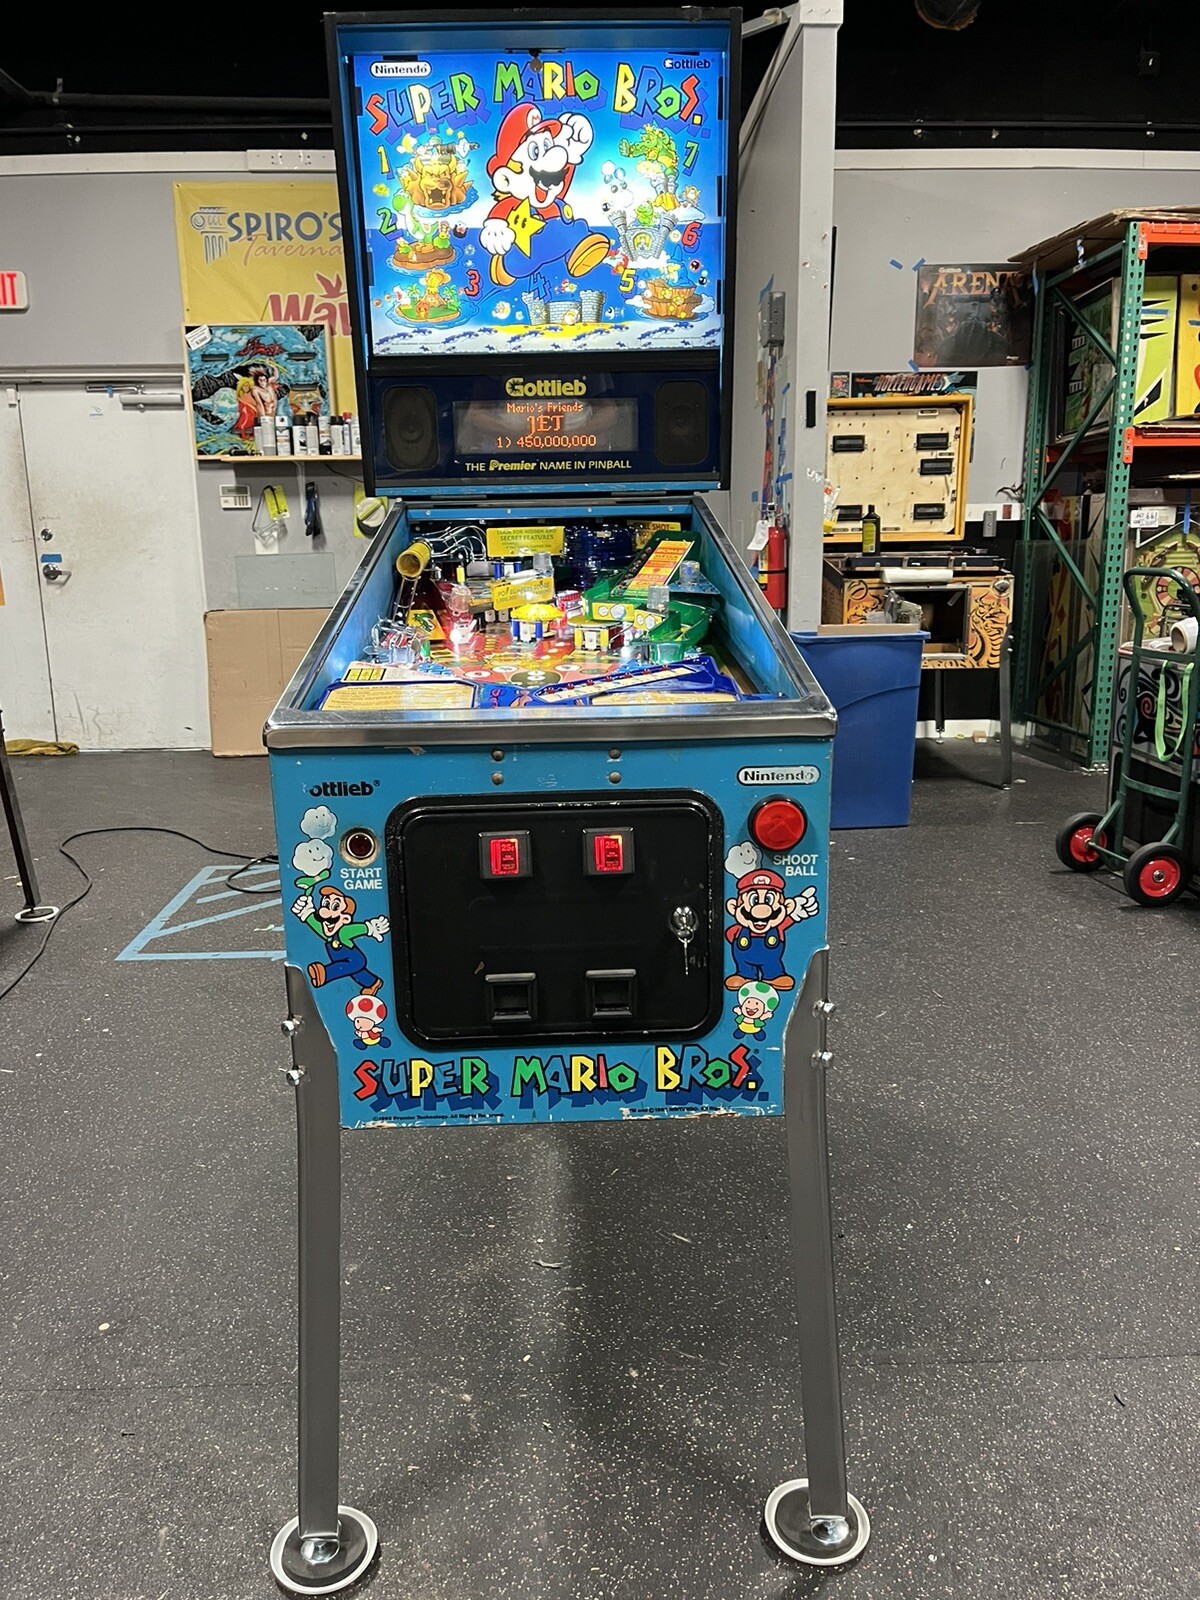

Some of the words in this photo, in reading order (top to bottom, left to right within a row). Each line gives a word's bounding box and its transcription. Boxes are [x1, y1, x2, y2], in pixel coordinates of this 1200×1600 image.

[375, 65, 427, 74] Nintendo
[663, 58, 711, 69] Gottlieb
[365, 73, 480, 135] SUPER
[494, 61, 600, 103] MARIO
[613, 62, 703, 125] BROS.
[377, 145, 391, 175] 1
[684, 141, 699, 168] 7
[227, 211, 343, 242] SPIRO'S
[377, 207, 397, 236] 2
[681, 221, 702, 247] 6
[239, 233, 345, 267] Taverna
[0, 273, 17, 306] IT
[464, 269, 480, 297] 3
[618, 268, 637, 293] 5
[505, 377, 587, 397] Gottlieb
[506, 402, 543, 413] Mario's
[547, 402, 584, 413] Friends
[527, 414, 564, 435] JET
[496, 436, 512, 448] 1)
[516, 434, 597, 449] 450,000,000
[465, 462, 486, 472] THE
[489, 460, 536, 471] Premier
[539, 461, 571, 470] NAME
[574, 460, 585, 470] IN
[588, 459, 632, 470] PINBALL
[743, 768, 814, 781] Nintendo
[309, 781, 374, 797] ottlieb
[773, 854, 818, 865] SHOOT
[340, 867, 382, 879] START
[785, 866, 818, 876] BALL
[344, 880, 383, 890] GAME
[353, 1056, 490, 1100] SUPER
[510, 1054, 638, 1097] MARIO
[655, 1043, 757, 1092] BROS.
